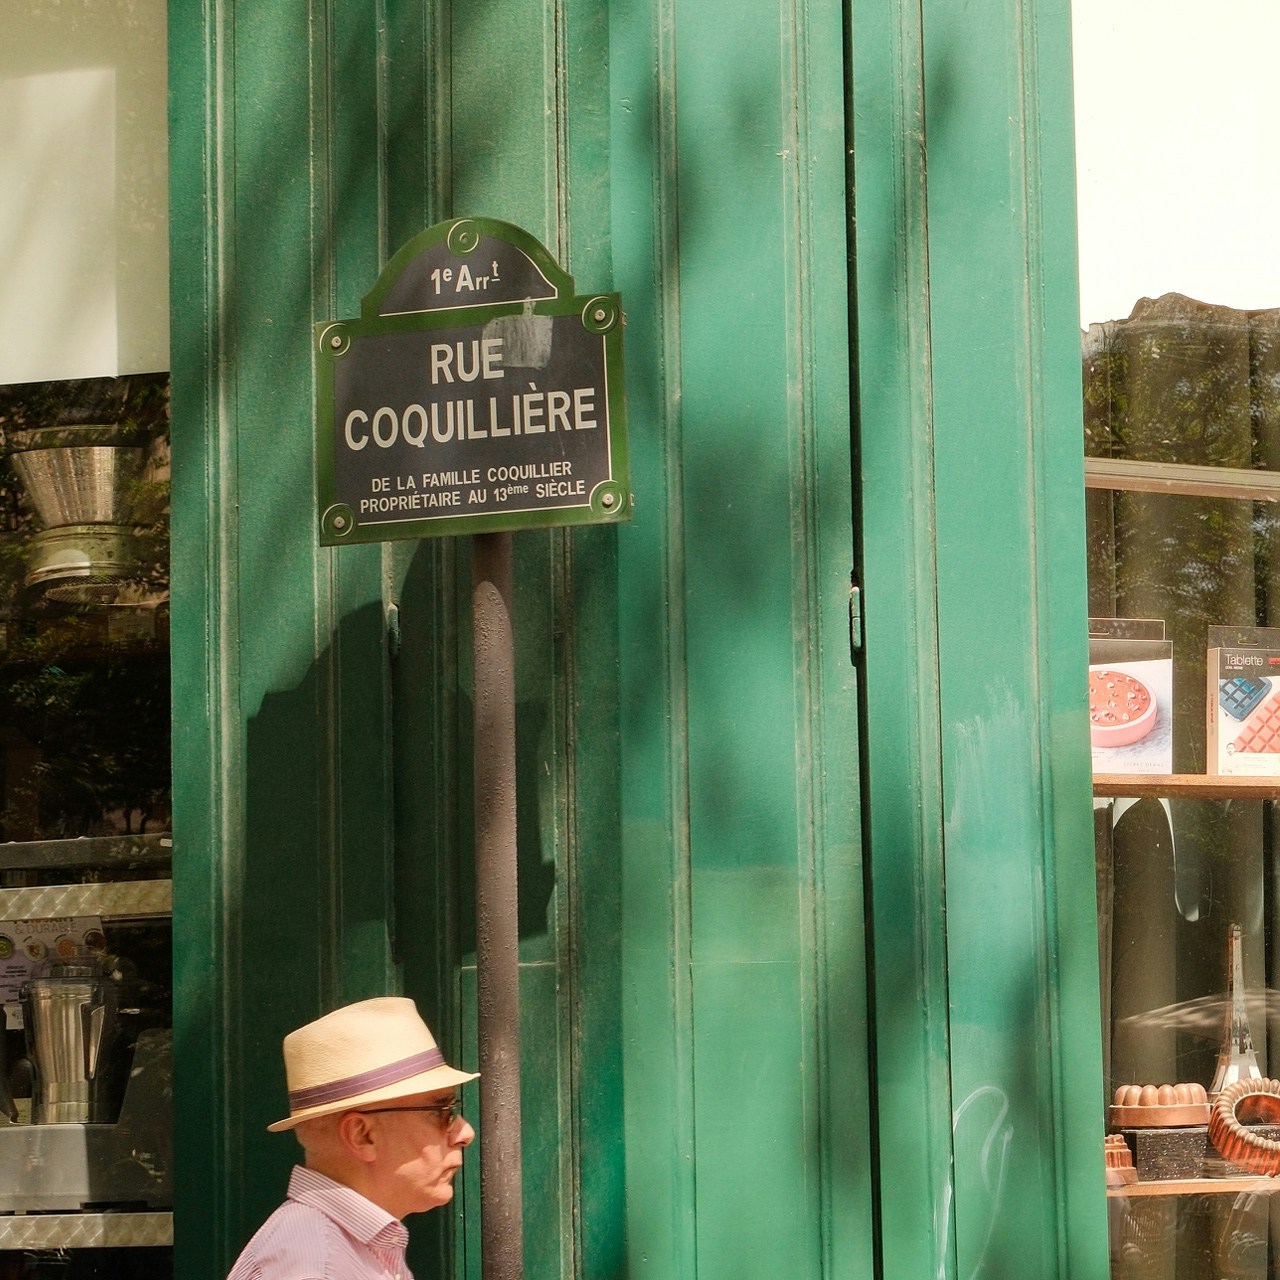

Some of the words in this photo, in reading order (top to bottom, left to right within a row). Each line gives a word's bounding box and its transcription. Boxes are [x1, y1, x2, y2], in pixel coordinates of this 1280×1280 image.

[430, 338, 505, 385] RUE
[344, 382, 598, 451] COQUILLIÈRE
[371, 477, 391, 493] DE
[397, 474, 416, 491] LA
[422, 469, 481, 489] FAMILLE
[487, 461, 572, 483] COQUILLIER
[360, 490, 461, 513] PROPRIÉTAIRE
[468, 488, 488, 505] AU
[493, 482, 529, 502] 13ème
[535, 477, 586, 498] SIÈCLE
[1224, 653, 1264, 666] Tablette
[27, 921, 78, 935] DURABLE
